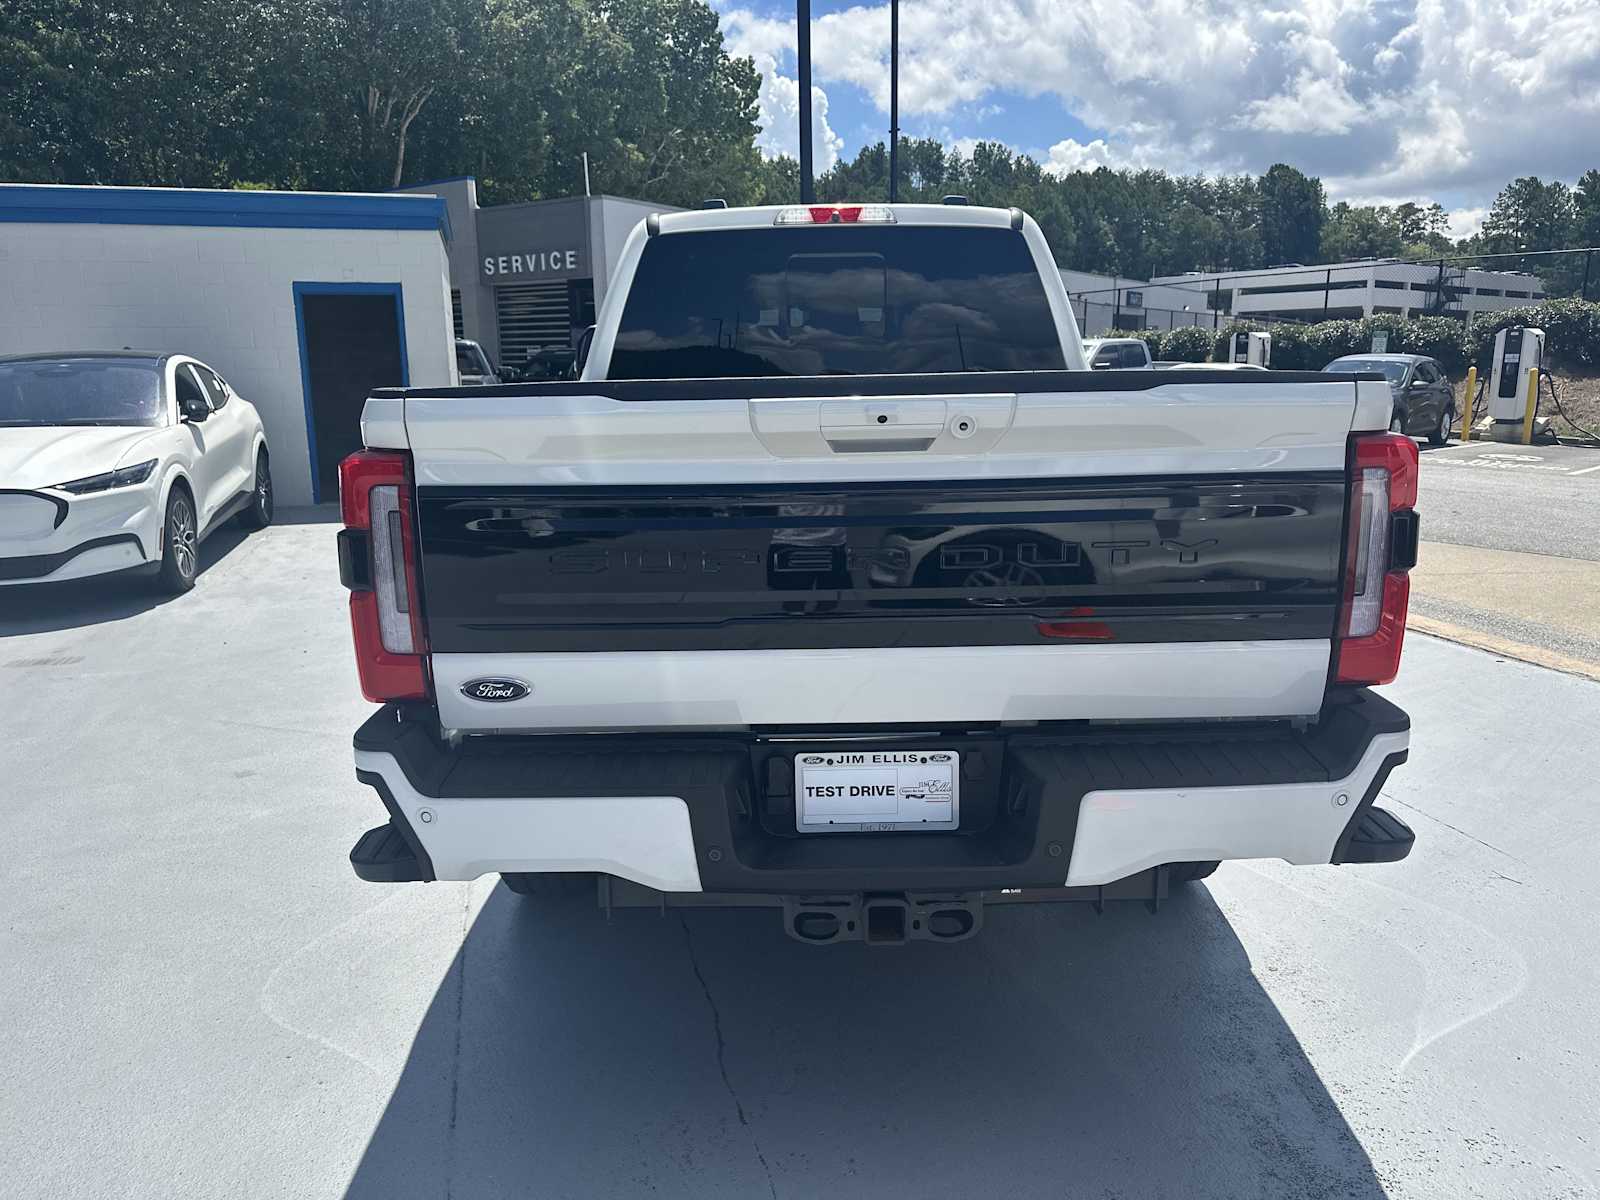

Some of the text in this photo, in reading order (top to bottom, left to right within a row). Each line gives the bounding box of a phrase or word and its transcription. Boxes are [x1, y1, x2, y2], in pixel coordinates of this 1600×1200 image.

[484, 250, 577, 275] SERVICE
[938, 537, 1220, 570] DUTY
[476, 682, 515, 698] Ford
[836, 754, 918, 764] JIM ELLIS
[805, 785, 896, 797] TEST DRIVE
